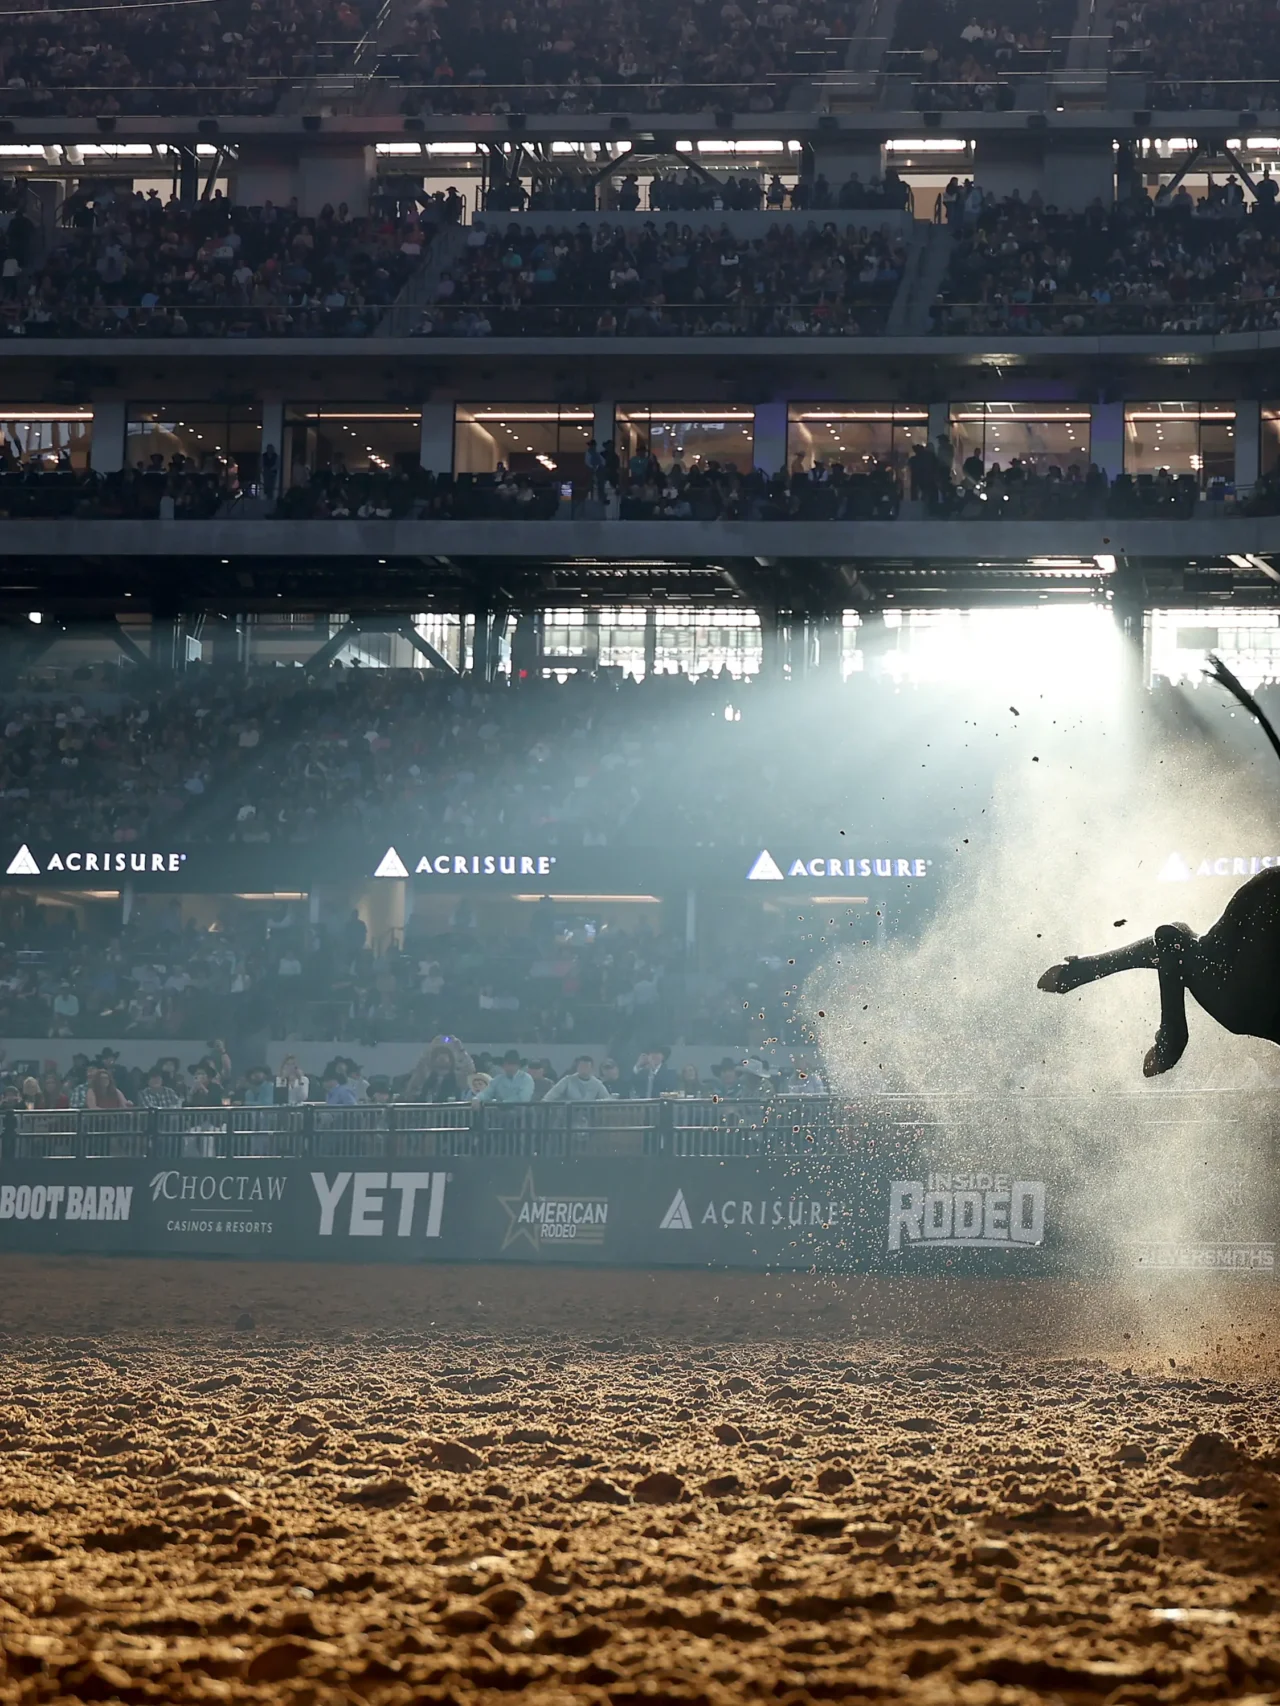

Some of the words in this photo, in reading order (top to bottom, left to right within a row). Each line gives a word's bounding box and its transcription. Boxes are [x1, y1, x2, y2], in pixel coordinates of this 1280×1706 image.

[46, 852, 182, 872] ACRISURE
[414, 855, 551, 874] ACRISURE
[787, 858, 927, 878] ACRISURE
[162, 1170, 288, 1201] CHOCTAW
[928, 1173, 1011, 1192] INSIDE
[0, 1184, 65, 1220] BOOT
[65, 1185, 134, 1221] BARN
[310, 1171, 446, 1237] YETI
[518, 1201, 609, 1225] AMERICAN
[700, 1200, 840, 1226] ACRISURE
[887, 1180, 1046, 1250] RODEO
[166, 1220, 214, 1232] CASINOS
[215, 1221, 222, 1232] &
[225, 1221, 273, 1233] RESORTS
[540, 1224, 577, 1240] RODEO
